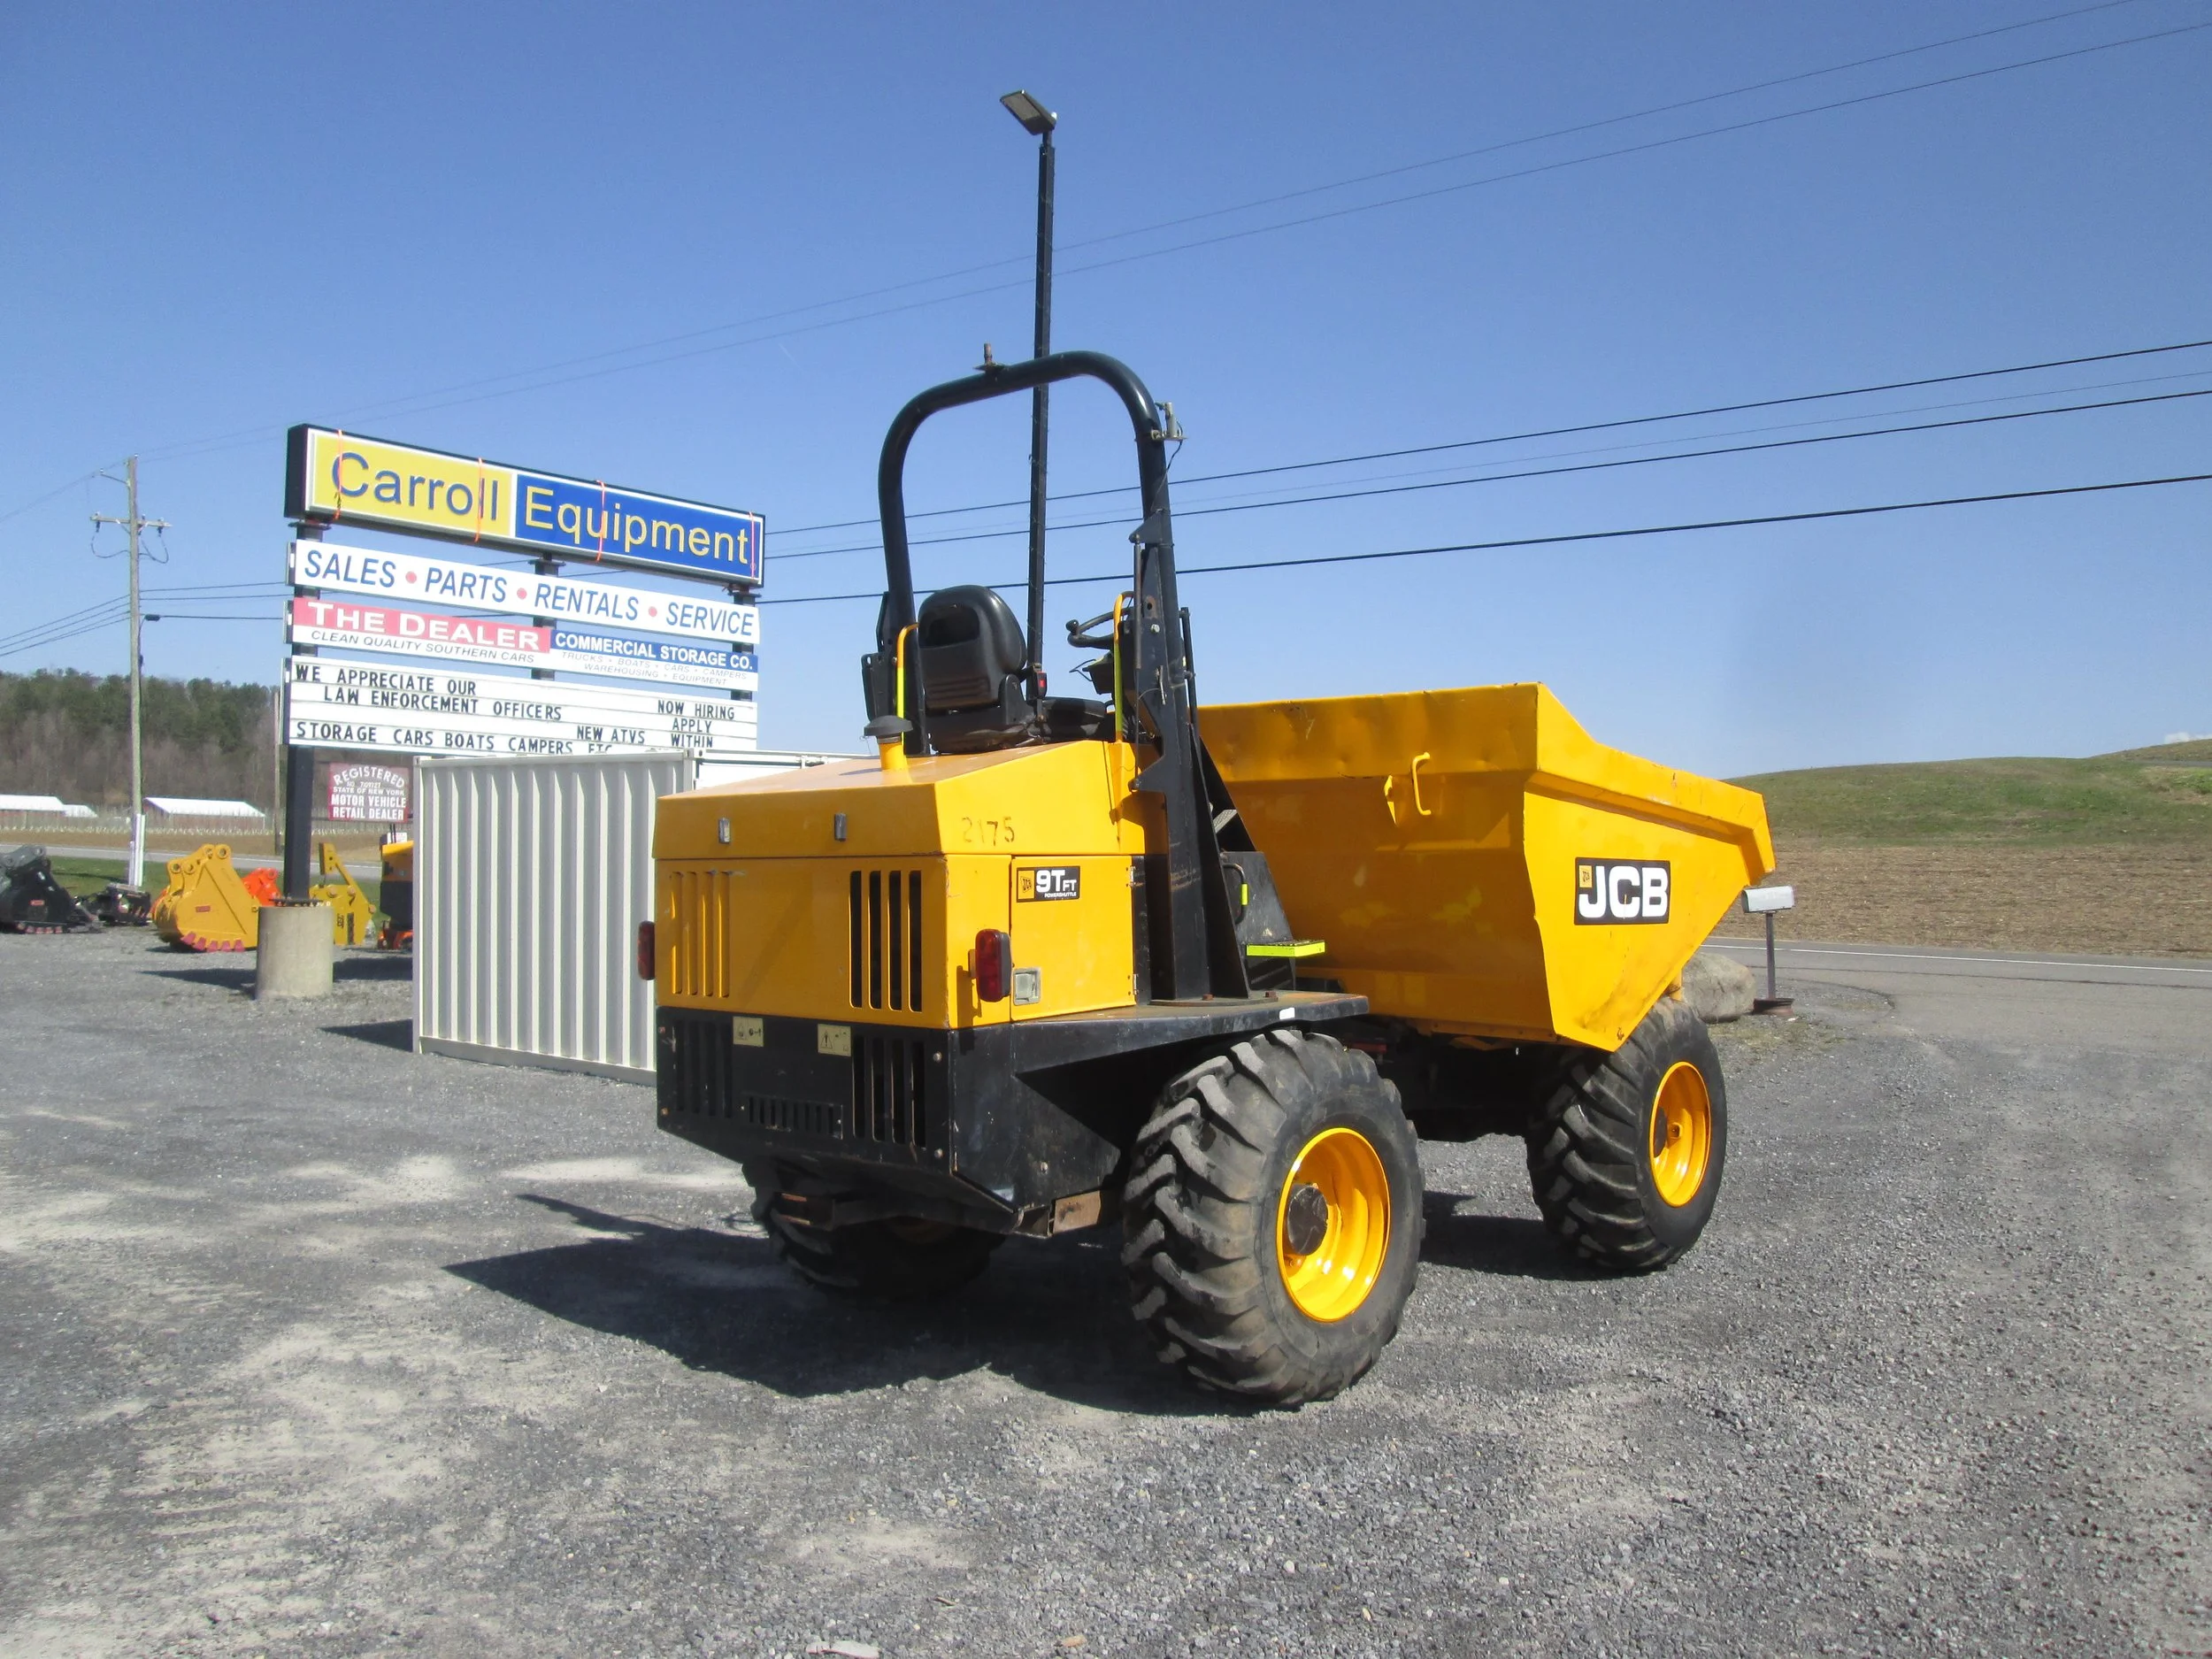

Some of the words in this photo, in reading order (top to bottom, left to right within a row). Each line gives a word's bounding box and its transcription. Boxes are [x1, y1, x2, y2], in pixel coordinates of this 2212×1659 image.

[332, 452, 498, 520] Carroll
[526, 486, 749, 564] Equipment
[304, 549, 396, 588] SALES
[425, 566, 507, 603] PARTS
[534, 583, 639, 620] RENTALS
[665, 602, 755, 636] SERVICE
[308, 602, 386, 633] THE
[399, 612, 539, 649] DEALER
[311, 630, 358, 644] CLEAN
[363, 636, 422, 652] QUALITY
[426, 643, 496, 659] SOUTHERN
[501, 651, 534, 663] CARS
[555, 632, 657, 658] COMMERCIAL
[660, 644, 726, 668] STORAGE
[730, 656, 753, 670] CO.
[296, 664, 320, 681] WE
[337, 668, 434, 692] APPRECIATE
[447, 679, 476, 695] OUR
[562, 651, 603, 663] TRUCKS
[618, 657, 650, 668] BOATS
[664, 664, 689, 673] CARS
[703, 668, 748, 680] CAMPERS
[584, 663, 658, 678] WAREHOUSING
[672, 673, 727, 686] EQUIPMENT
[325, 686, 359, 705] LAW
[371, 690, 479, 714] ENFORCEMENT
[493, 701, 562, 721] OFFICERS
[657, 699, 684, 716] NOW
[695, 703, 734, 720] HIRING
[296, 721, 377, 742] STORAGE
[393, 728, 434, 746] CARS
[444, 732, 495, 749] BOATS
[508, 736, 573, 754] CAMPERS
[577, 726, 603, 741] NEW
[611, 728, 645, 744] ATVS
[672, 718, 712, 734] APPLY
[671, 733, 713, 749] WITHIN
[333, 765, 404, 787] REGISTERED
[331, 795, 365, 806] MOTOR
[368, 795, 406, 808] VEHICLE
[333, 806, 365, 818] RETAIL
[369, 808, 403, 820] DEALER
[962, 817, 1015, 846] 2175
[1578, 865, 1668, 918] JCB
